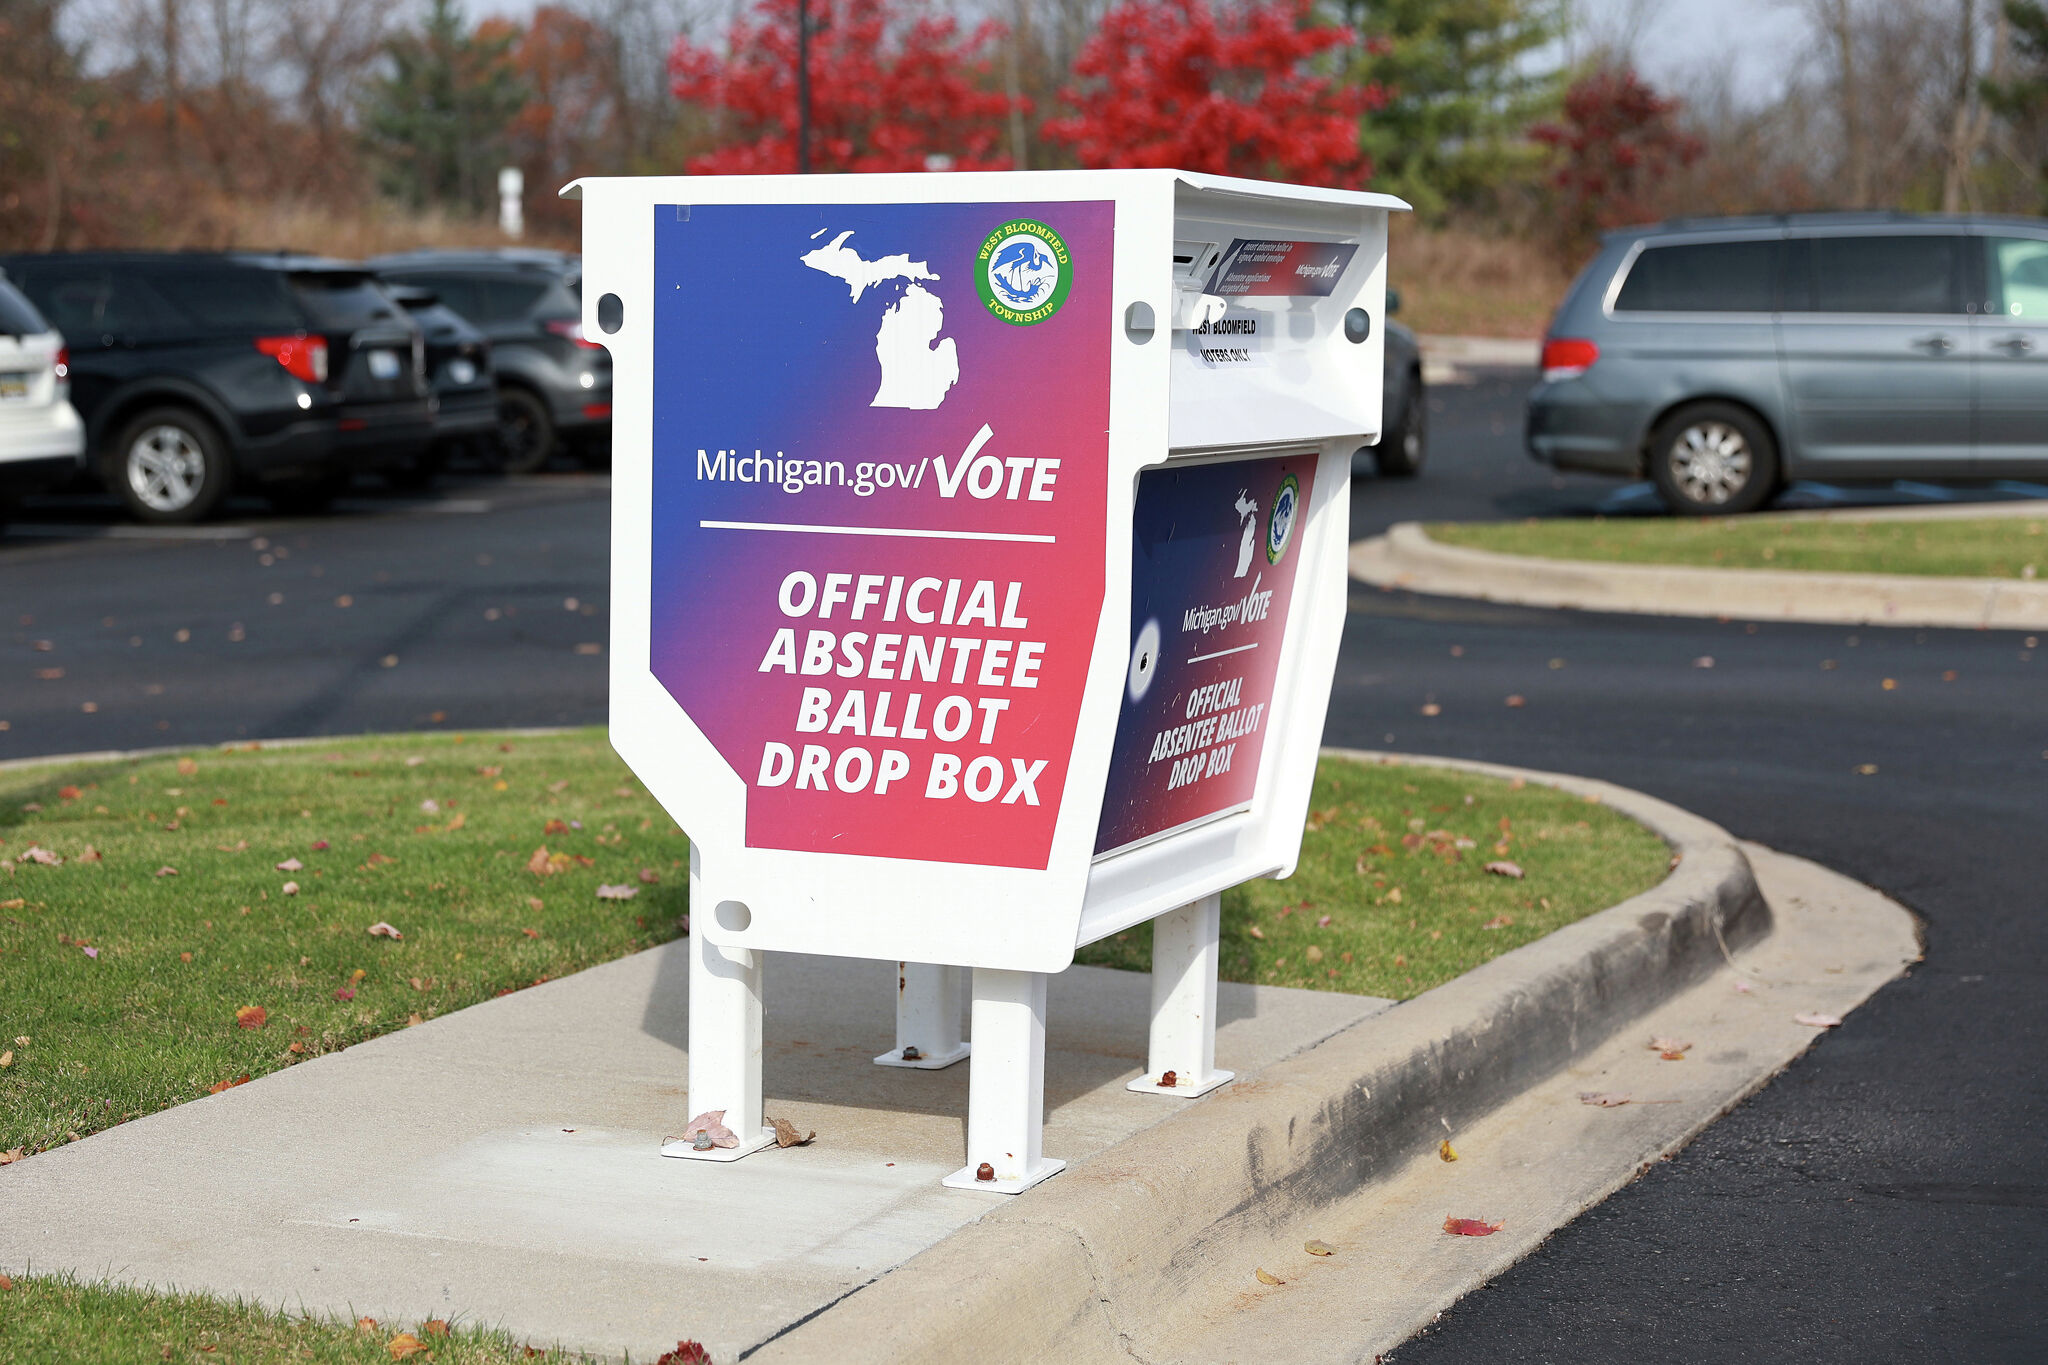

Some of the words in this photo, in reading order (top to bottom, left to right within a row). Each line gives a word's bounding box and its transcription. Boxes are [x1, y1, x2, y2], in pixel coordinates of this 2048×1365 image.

[979, 230, 1002, 260] WEST
[1004, 222, 1068, 264] BLOOMFIELD
[988, 298, 1054, 323] TOWNSHIP
[1213, 319, 1256, 335] BLOOMFIELD
[1200, 348, 1232, 362] VOTERS
[1229, 348, 1252, 362] ONLY
[778, 570, 1028, 629] OFFICIAL
[757, 628, 1047, 689] ABSENTEE
[795, 686, 1011, 744] BALLOT
[1185, 676, 1244, 720] OFFICIAL
[1148, 715, 1218, 764] ABSENTEE
[1215, 703, 1265, 744] BALLOT
[756, 741, 910, 795] DROP
[924, 752, 1050, 806] BOX
[1167, 752, 1207, 791] DROP
[1205, 743, 1237, 779] BOX
